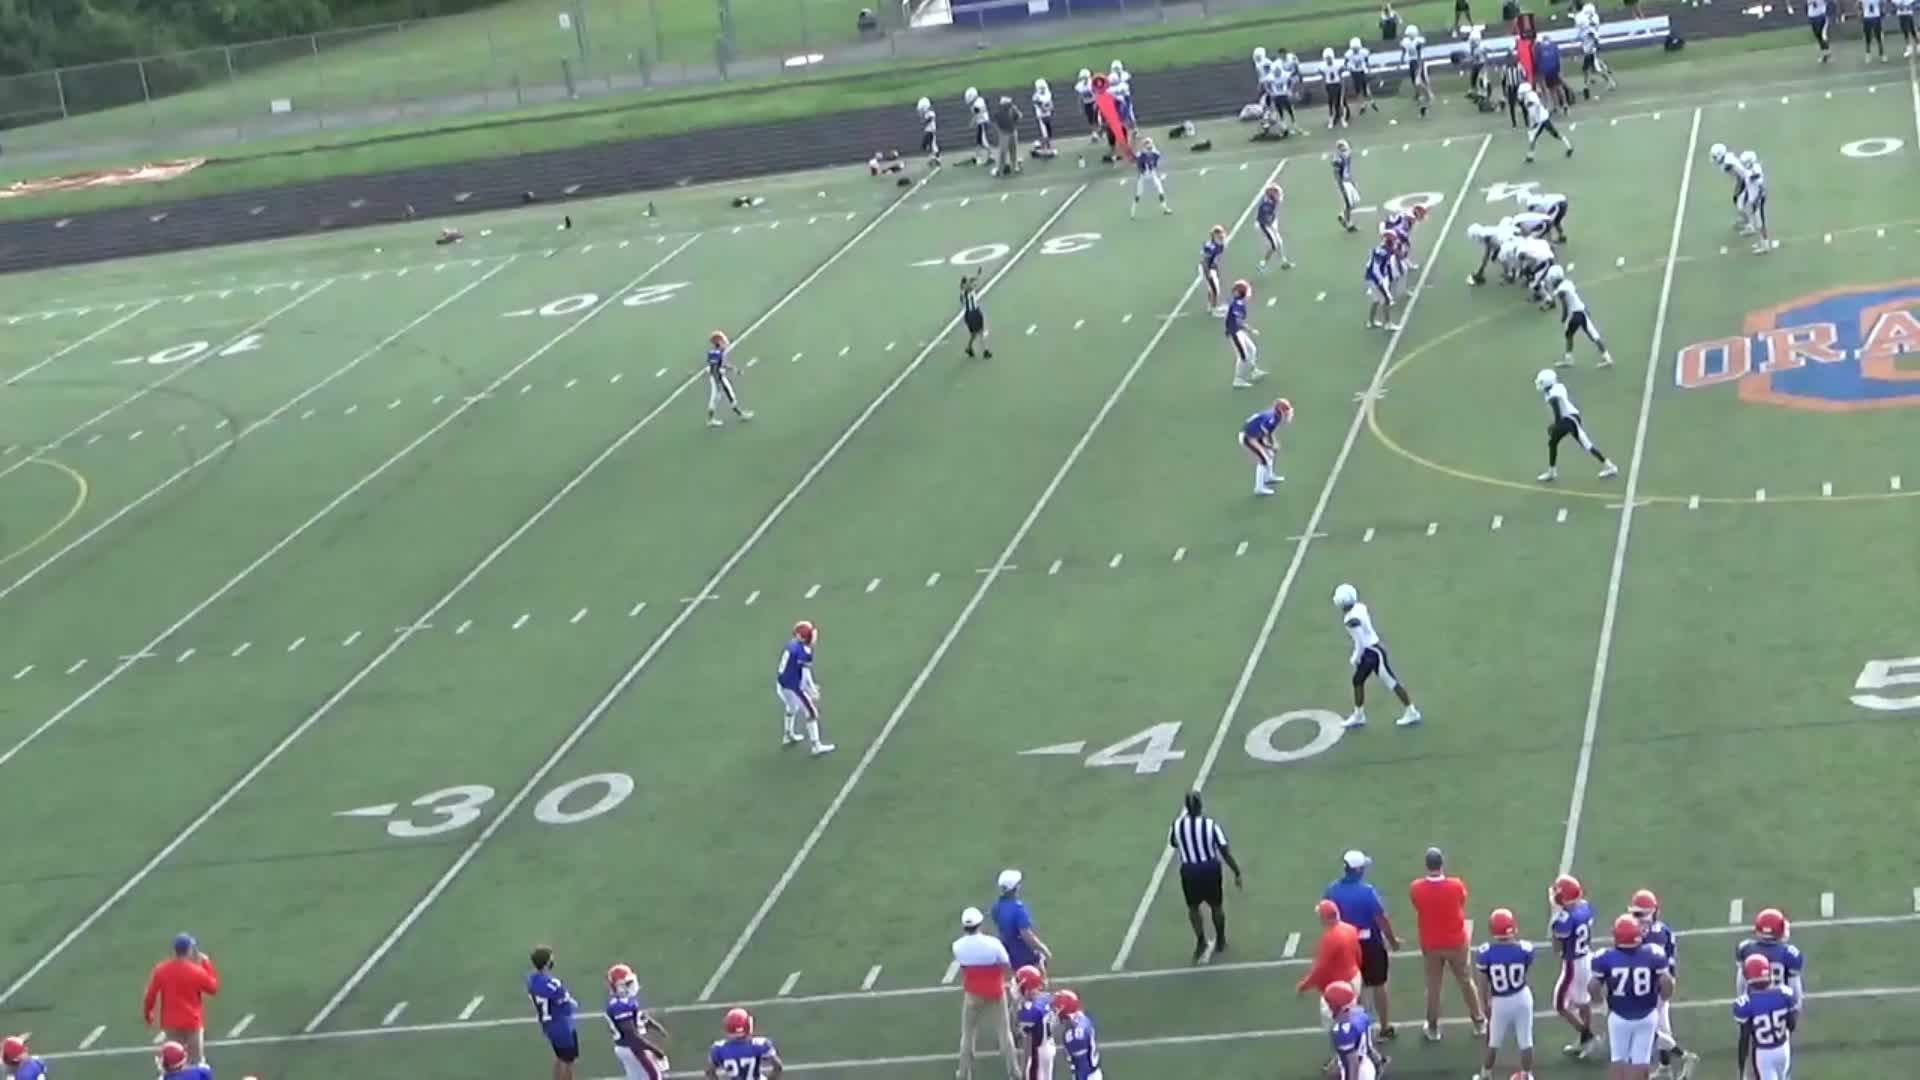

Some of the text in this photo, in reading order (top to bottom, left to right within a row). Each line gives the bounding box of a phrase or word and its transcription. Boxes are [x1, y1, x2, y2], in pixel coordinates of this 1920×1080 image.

[1489, 963, 1525, 993] 80
[1611, 967, 1651, 997] 78
[1753, 1008, 1789, 1044] 25
